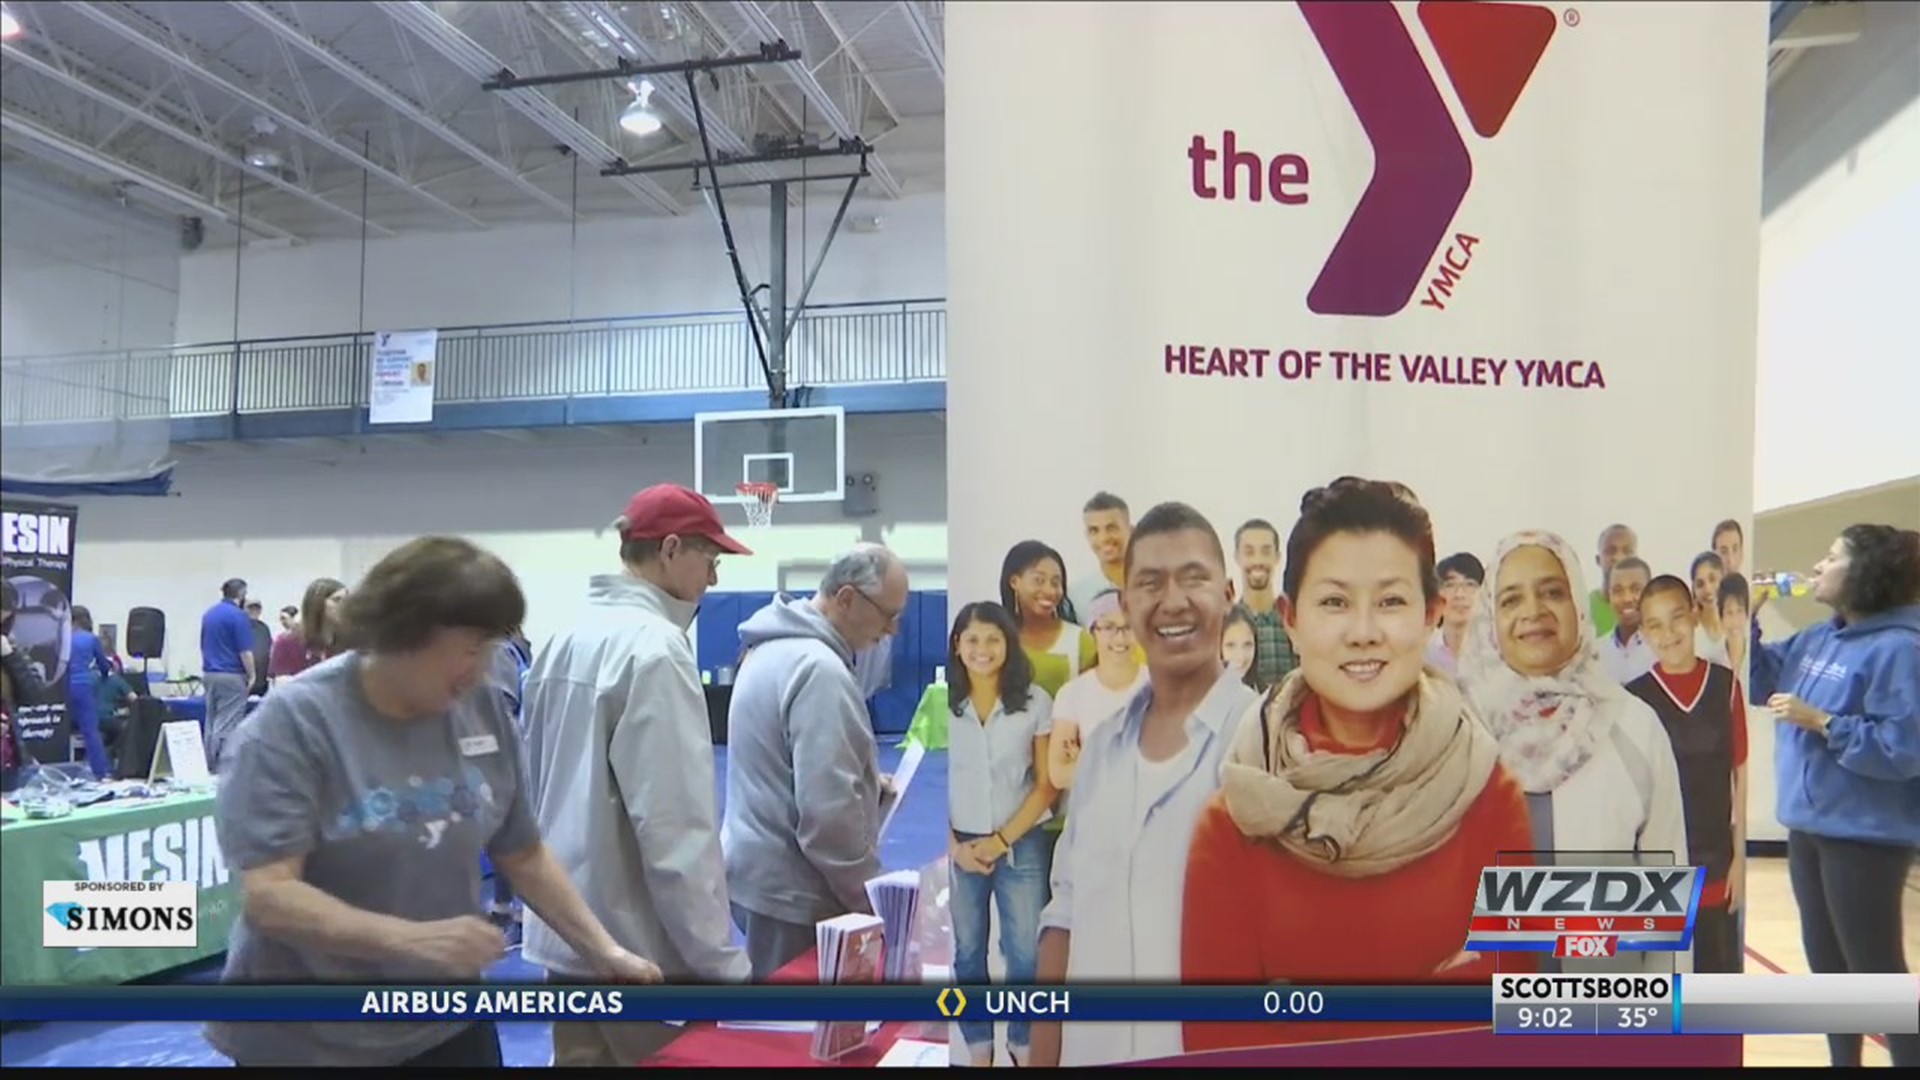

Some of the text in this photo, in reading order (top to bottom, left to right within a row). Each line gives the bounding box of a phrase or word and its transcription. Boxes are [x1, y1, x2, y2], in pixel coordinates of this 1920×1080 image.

[1187, 130, 1310, 205] the
[1421, 232, 1480, 311] YMCA
[1164, 343, 1606, 390] HEART OF THE VALLEY YMCA
